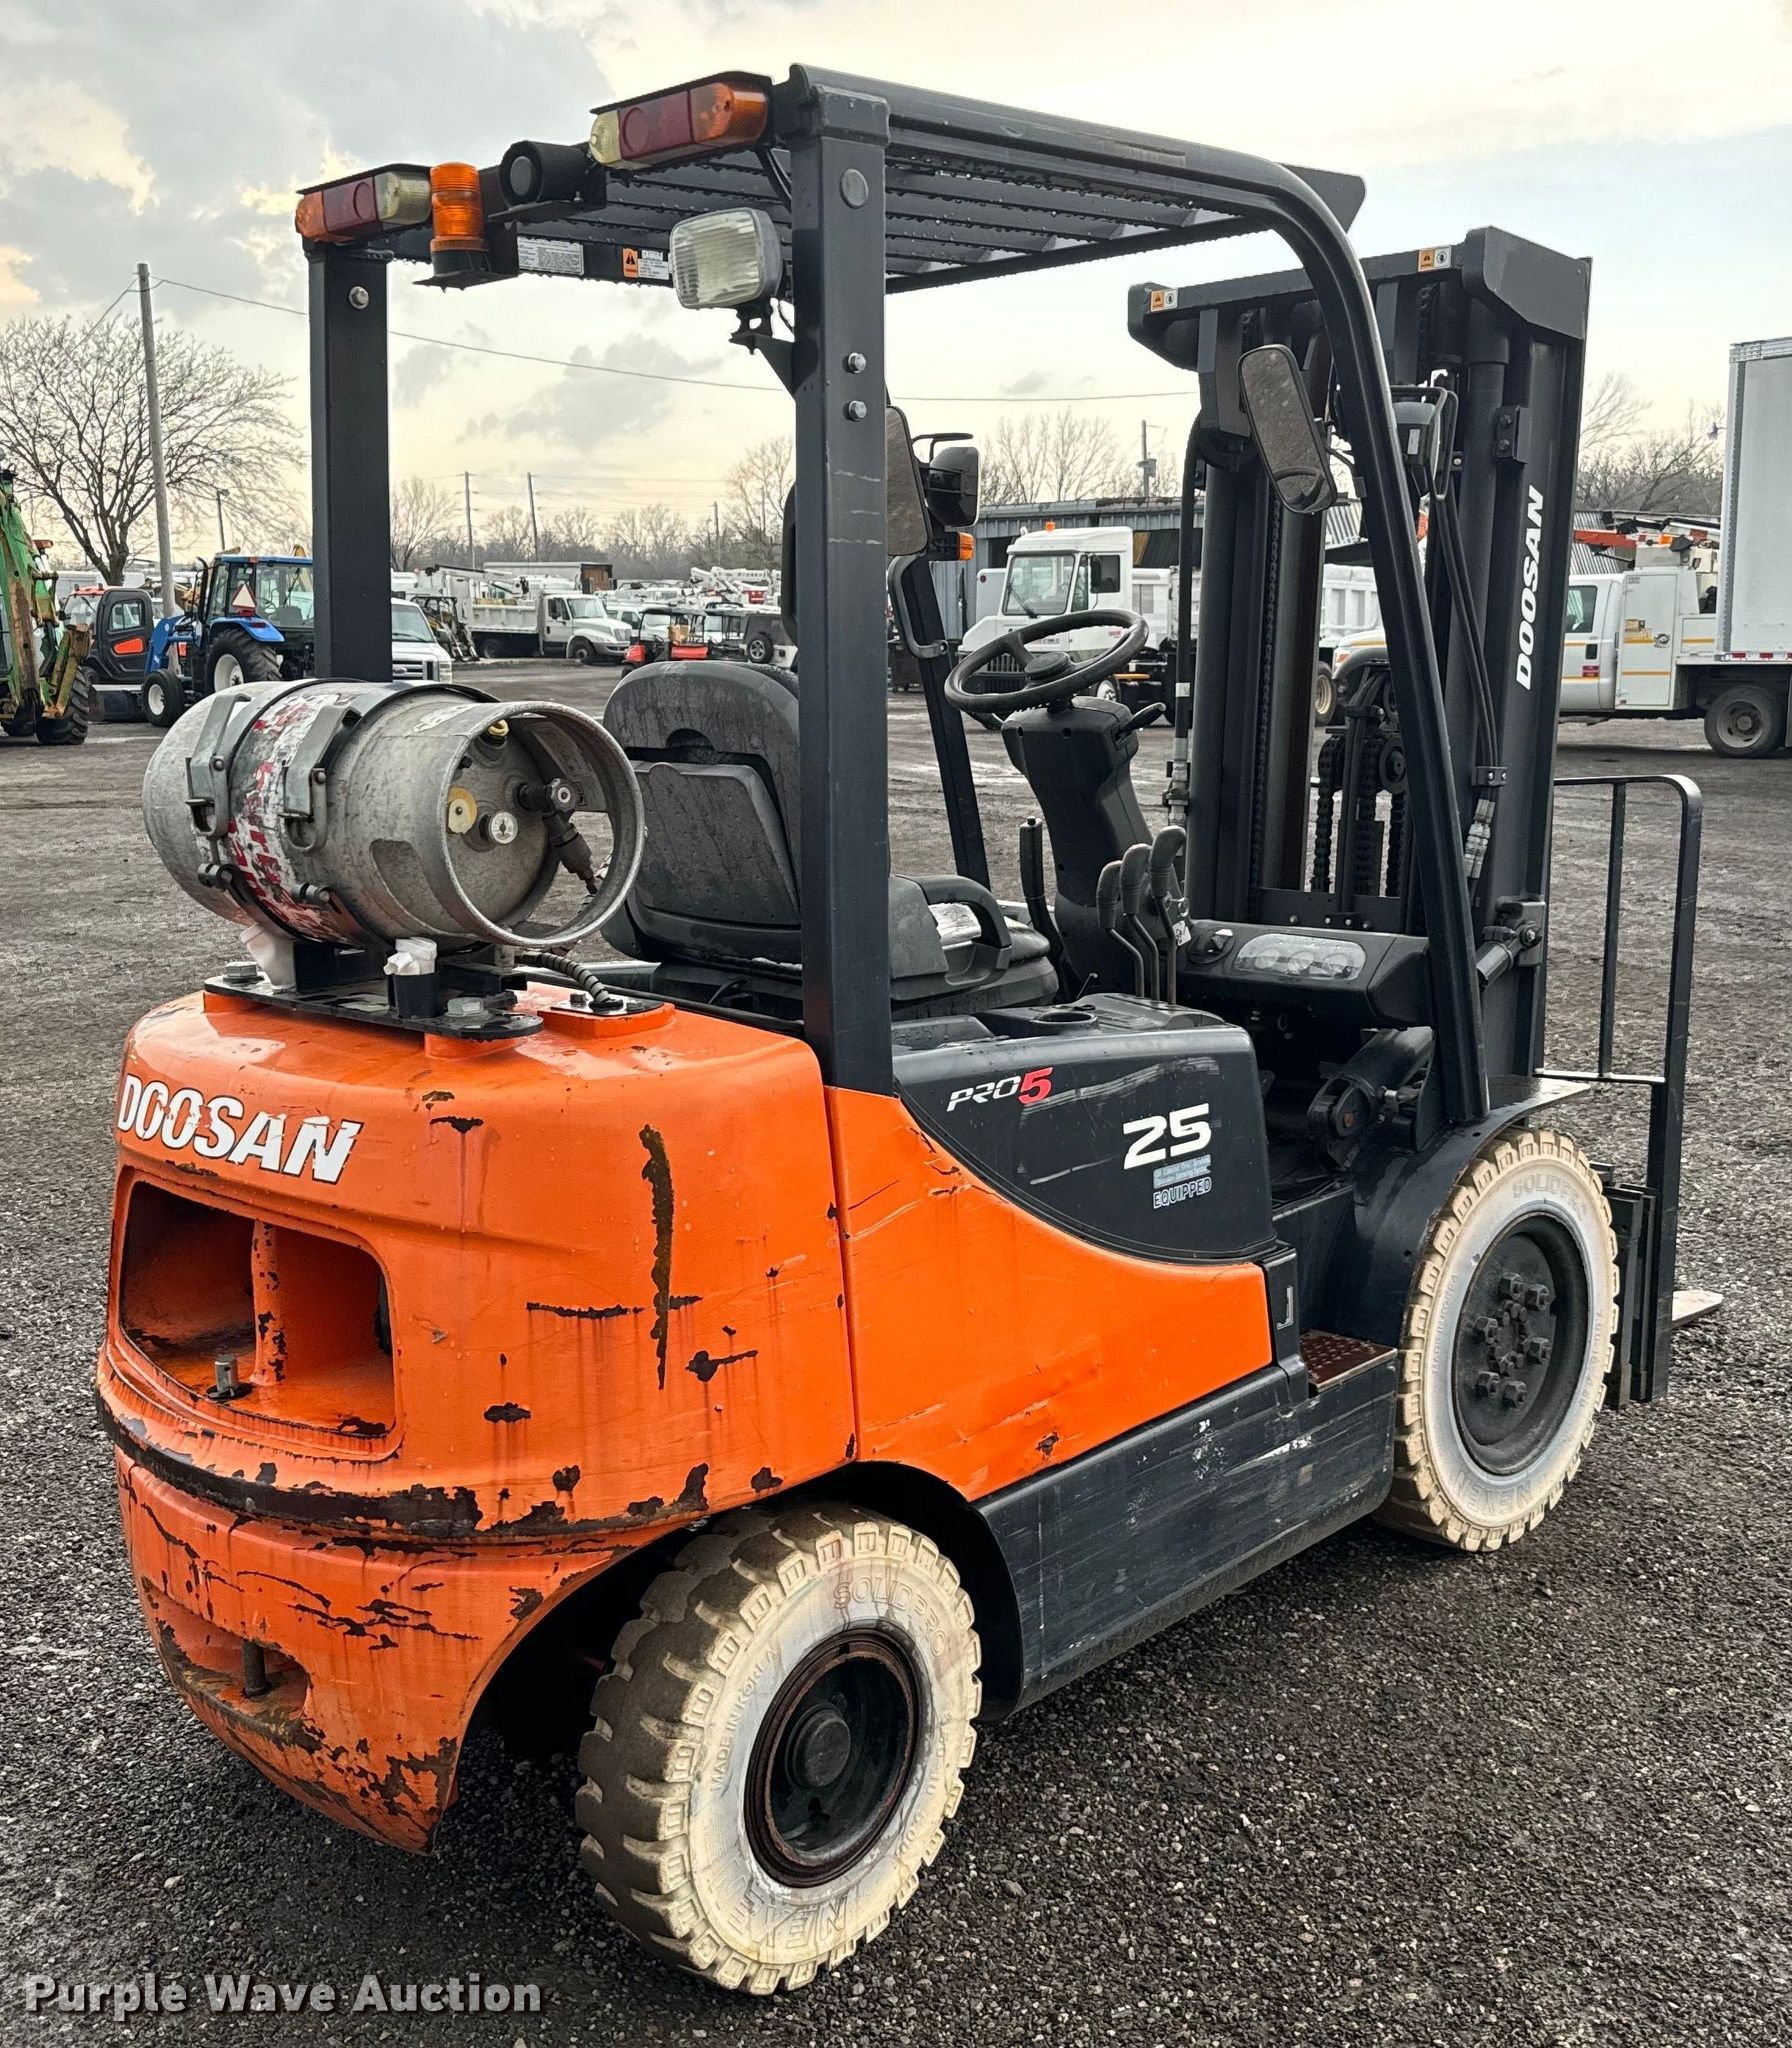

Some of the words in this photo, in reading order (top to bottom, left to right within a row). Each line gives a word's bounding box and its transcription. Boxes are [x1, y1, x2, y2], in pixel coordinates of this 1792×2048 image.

[1516, 484, 1544, 690] DOOSAN
[117, 1073, 365, 1184] DOOSAN
[1123, 1103, 1211, 1170] 25
[1153, 1177, 1212, 1209] EQUIPPED
[833, 1576, 947, 1658] SOLIDPRO
[710, 1735, 734, 1792] MADE
[726, 1712, 742, 1731] IN
